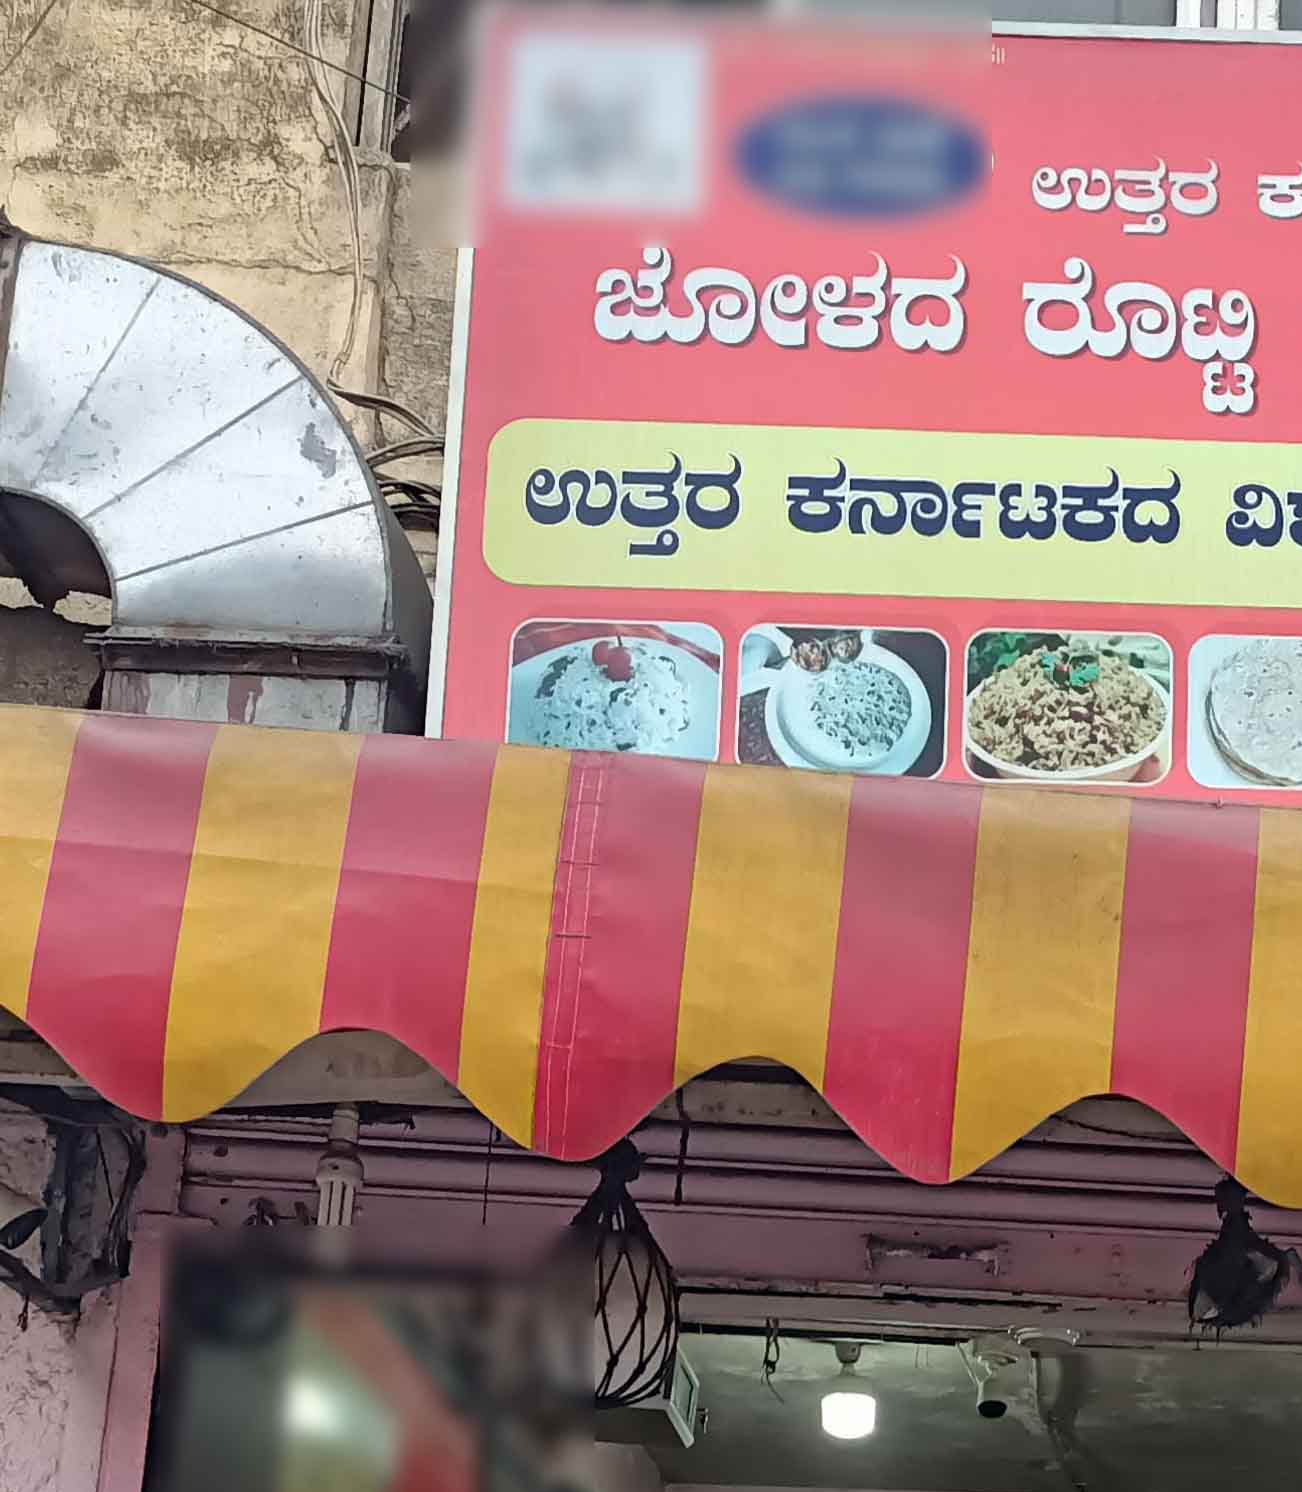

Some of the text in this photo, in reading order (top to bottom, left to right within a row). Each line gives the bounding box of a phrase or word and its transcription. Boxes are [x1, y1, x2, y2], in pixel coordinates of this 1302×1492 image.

[1031, 158, 1221, 236] ಉತ್ತರ
[592, 246, 968, 354] ಜೋಳದ
[1021, 256, 1258, 415] ರೊಟ್ಟಿ
[524, 450, 743, 557] ಉತ್ತರ
[785, 457, 1182, 545] ಕರ್ನಾಟಕದ
